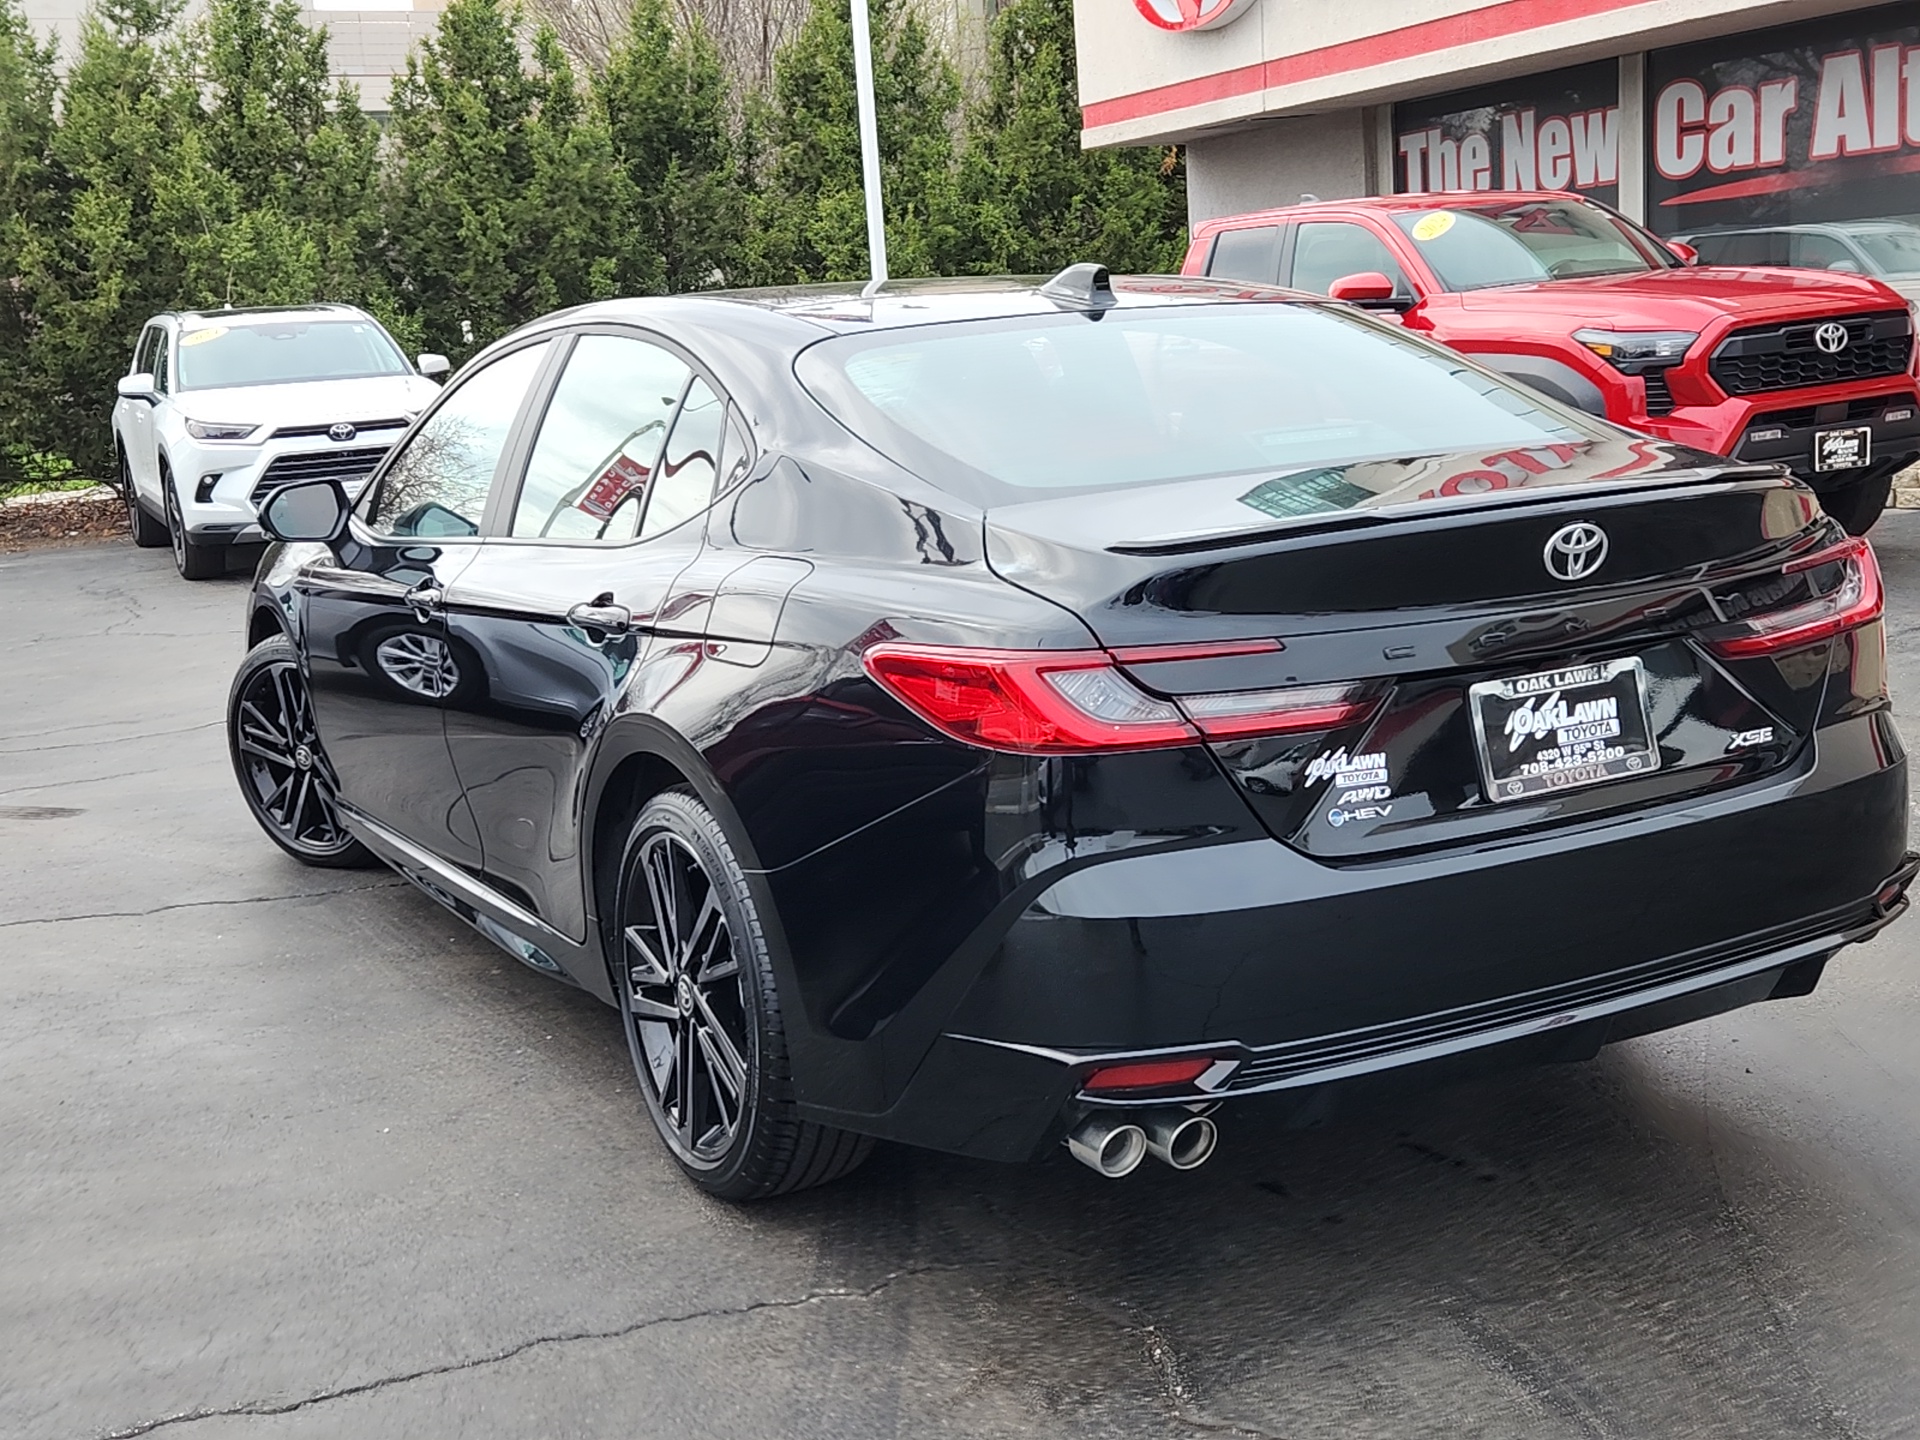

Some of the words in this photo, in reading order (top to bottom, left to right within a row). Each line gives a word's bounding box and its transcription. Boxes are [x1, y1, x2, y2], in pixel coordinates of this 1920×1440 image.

[1400, 127, 1493, 192] The
[1502, 104, 1620, 191] New
[1654, 75, 1798, 181] Car
[1516, 676, 1551, 693] OAK
[1554, 667, 1599, 688] LAWN
[1564, 722, 1613, 742] TOYOTA
[1728, 726, 1773, 750] XSE
[1520, 746, 1624, 775] 708-423-5200
[1536, 748, 1560, 761] 4320
[1561, 745, 1572, 757] W
[1573, 742, 1592, 754] 95
[1593, 740, 1606, 751] St
[1342, 771, 1381, 783] TOYOTA
[1542, 764, 1608, 788] TOYOTA
[1337, 785, 1392, 805] AWD
